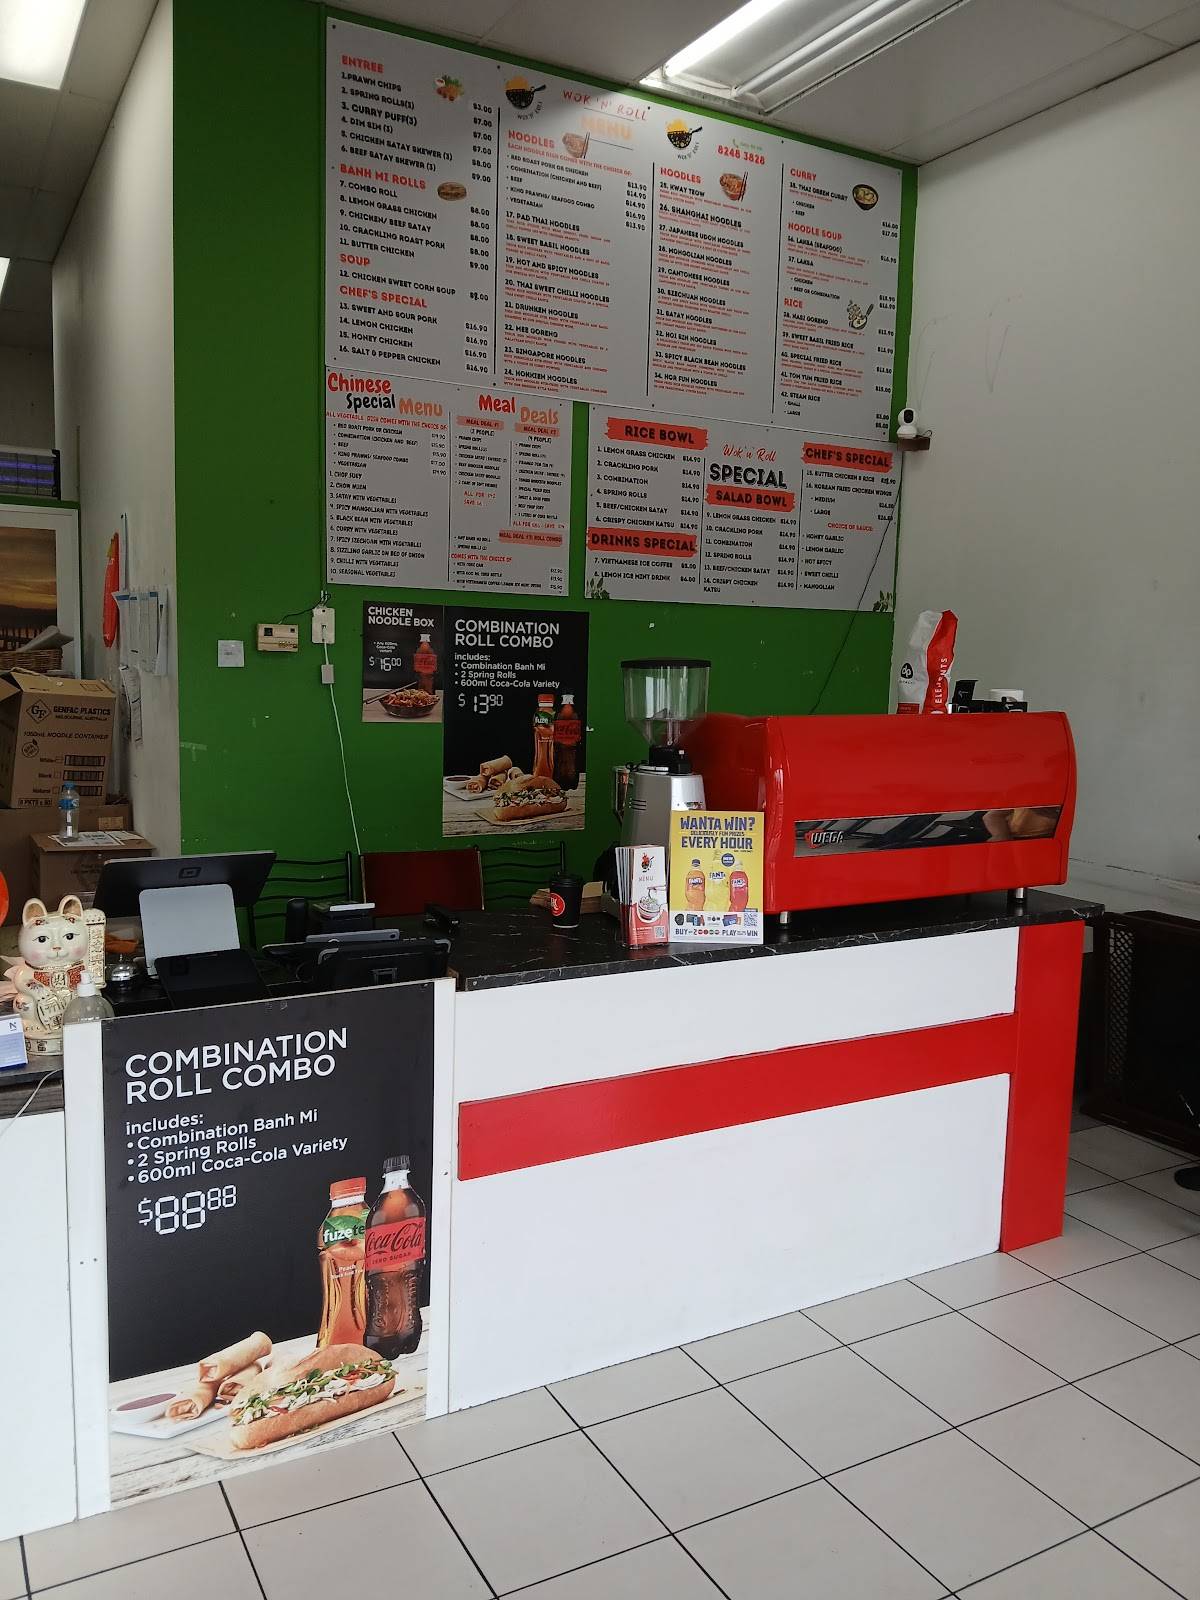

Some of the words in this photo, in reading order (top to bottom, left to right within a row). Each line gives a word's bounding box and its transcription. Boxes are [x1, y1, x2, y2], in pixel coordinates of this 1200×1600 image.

[342, 55, 383, 73] ENTREE
[351, 103, 382, 118] CURRY
[564, 91, 591, 104] WOK
[617, 104, 646, 120] ROLL
[508, 130, 554, 147] NOODLES
[340, 163, 371, 178] BANH
[375, 169, 388, 182] MI
[392, 174, 425, 189] ROLLS
[660, 167, 701, 184] NOODLES
[790, 168, 816, 181] CURRY
[348, 182, 376, 193] COMBO
[378, 188, 397, 198] ROLL
[516, 212, 530, 221] PAD
[531, 215, 547, 225] THAI
[549, 219, 579, 231] NOODLES
[671, 206, 708, 220] SHANGHAI
[710, 215, 741, 228] NOODLES
[352, 225, 397, 240] CRACKLING
[399, 234, 423, 245] ROAST
[425, 239, 445, 249] PORK
[788, 222, 819, 236] NOODLE
[821, 229, 841, 240] SOUP
[351, 239, 378, 250] BUTTER
[380, 245, 414, 258] CHICKEN
[340, 253, 369, 266] SOUP
[351, 271, 386, 283] CHICKEN
[388, 277, 411, 288] SWEET
[413, 282, 434, 291] CORN
[436, 286, 455, 295] SOUP
[516, 280, 532, 289] THAI
[534, 283, 555, 293] SWEET
[580, 292, 609, 302] NOODLES
[339, 285, 378, 299] CHEF'S
[381, 291, 427, 308] SPECIAL
[784, 297, 802, 308] RICE
[351, 332, 377, 342] HONEY
[378, 336, 412, 347] CHICKEN
[328, 373, 392, 394] Chinese
[346, 392, 395, 413] Special
[399, 398, 442, 416] Menu
[478, 394, 515, 413] Meal
[520, 406, 558, 424] Deals
[624, 425, 655, 439] RICE
[659, 429, 693, 444] BOWL
[603, 446, 625, 454] LEMON
[647, 451, 675, 460] CHICKEN
[722, 443, 743, 458] Wok
[756, 447, 776, 462] Roll
[804, 447, 842, 461] CHEF'S
[845, 452, 890, 467] SPECIAL
[603, 460, 640, 470] CRACKLING
[603, 474, 648, 484] COMBINATION
[709, 463, 787, 489] SPECIAL
[715, 490, 752, 503] SALAD
[755, 493, 786, 507] BOWL
[591, 533, 640, 547] DRINKS
[643, 537, 697, 553] SPECIAL
[367, 606, 412, 616] CHICKEN
[368, 615, 411, 626] NOODLE
[413, 617, 434, 627] BOX
[454, 619, 559, 634] COMBINATION
[455, 633, 494, 646] ROLL
[499, 634, 553, 648] COMBO
[454, 652, 490, 660] includes:
[460, 661, 512, 670] Combination
[460, 670, 466, 680] 2
[467, 670, 495, 680] Spring
[496, 670, 517, 681] Rolls
[460, 678, 487, 686] 600ml
[489, 678, 530, 687] Coca-Cola
[532, 680, 560, 688] Variety
[80, 708, 110, 716] PLASTICS
[680, 815, 721, 830] WANTA
[724, 816, 755, 830] WIN?
[681, 836, 718, 848] EVERY
[720, 836, 753, 849] HOUR
[810, 830, 844, 844] WEGA
[125, 1027, 346, 1077] COMBINATION
[126, 1072, 212, 1104] ROLL
[222, 1054, 335, 1089] COMBO
[126, 1114, 203, 1135] includes:
[137, 1123, 248, 1149] Combination
[254, 1113, 294, 1131] Banh
[300, 1108, 317, 1123] Mi
[137, 1153, 148, 1167] 2
[154, 1145, 210, 1165] Spring
[216, 1136, 256, 1154] Rolls
[138, 1161, 195, 1183] 600ml
[200, 1147, 286, 1172] Coca-Cola
[292, 1137, 347, 1156] Variety
